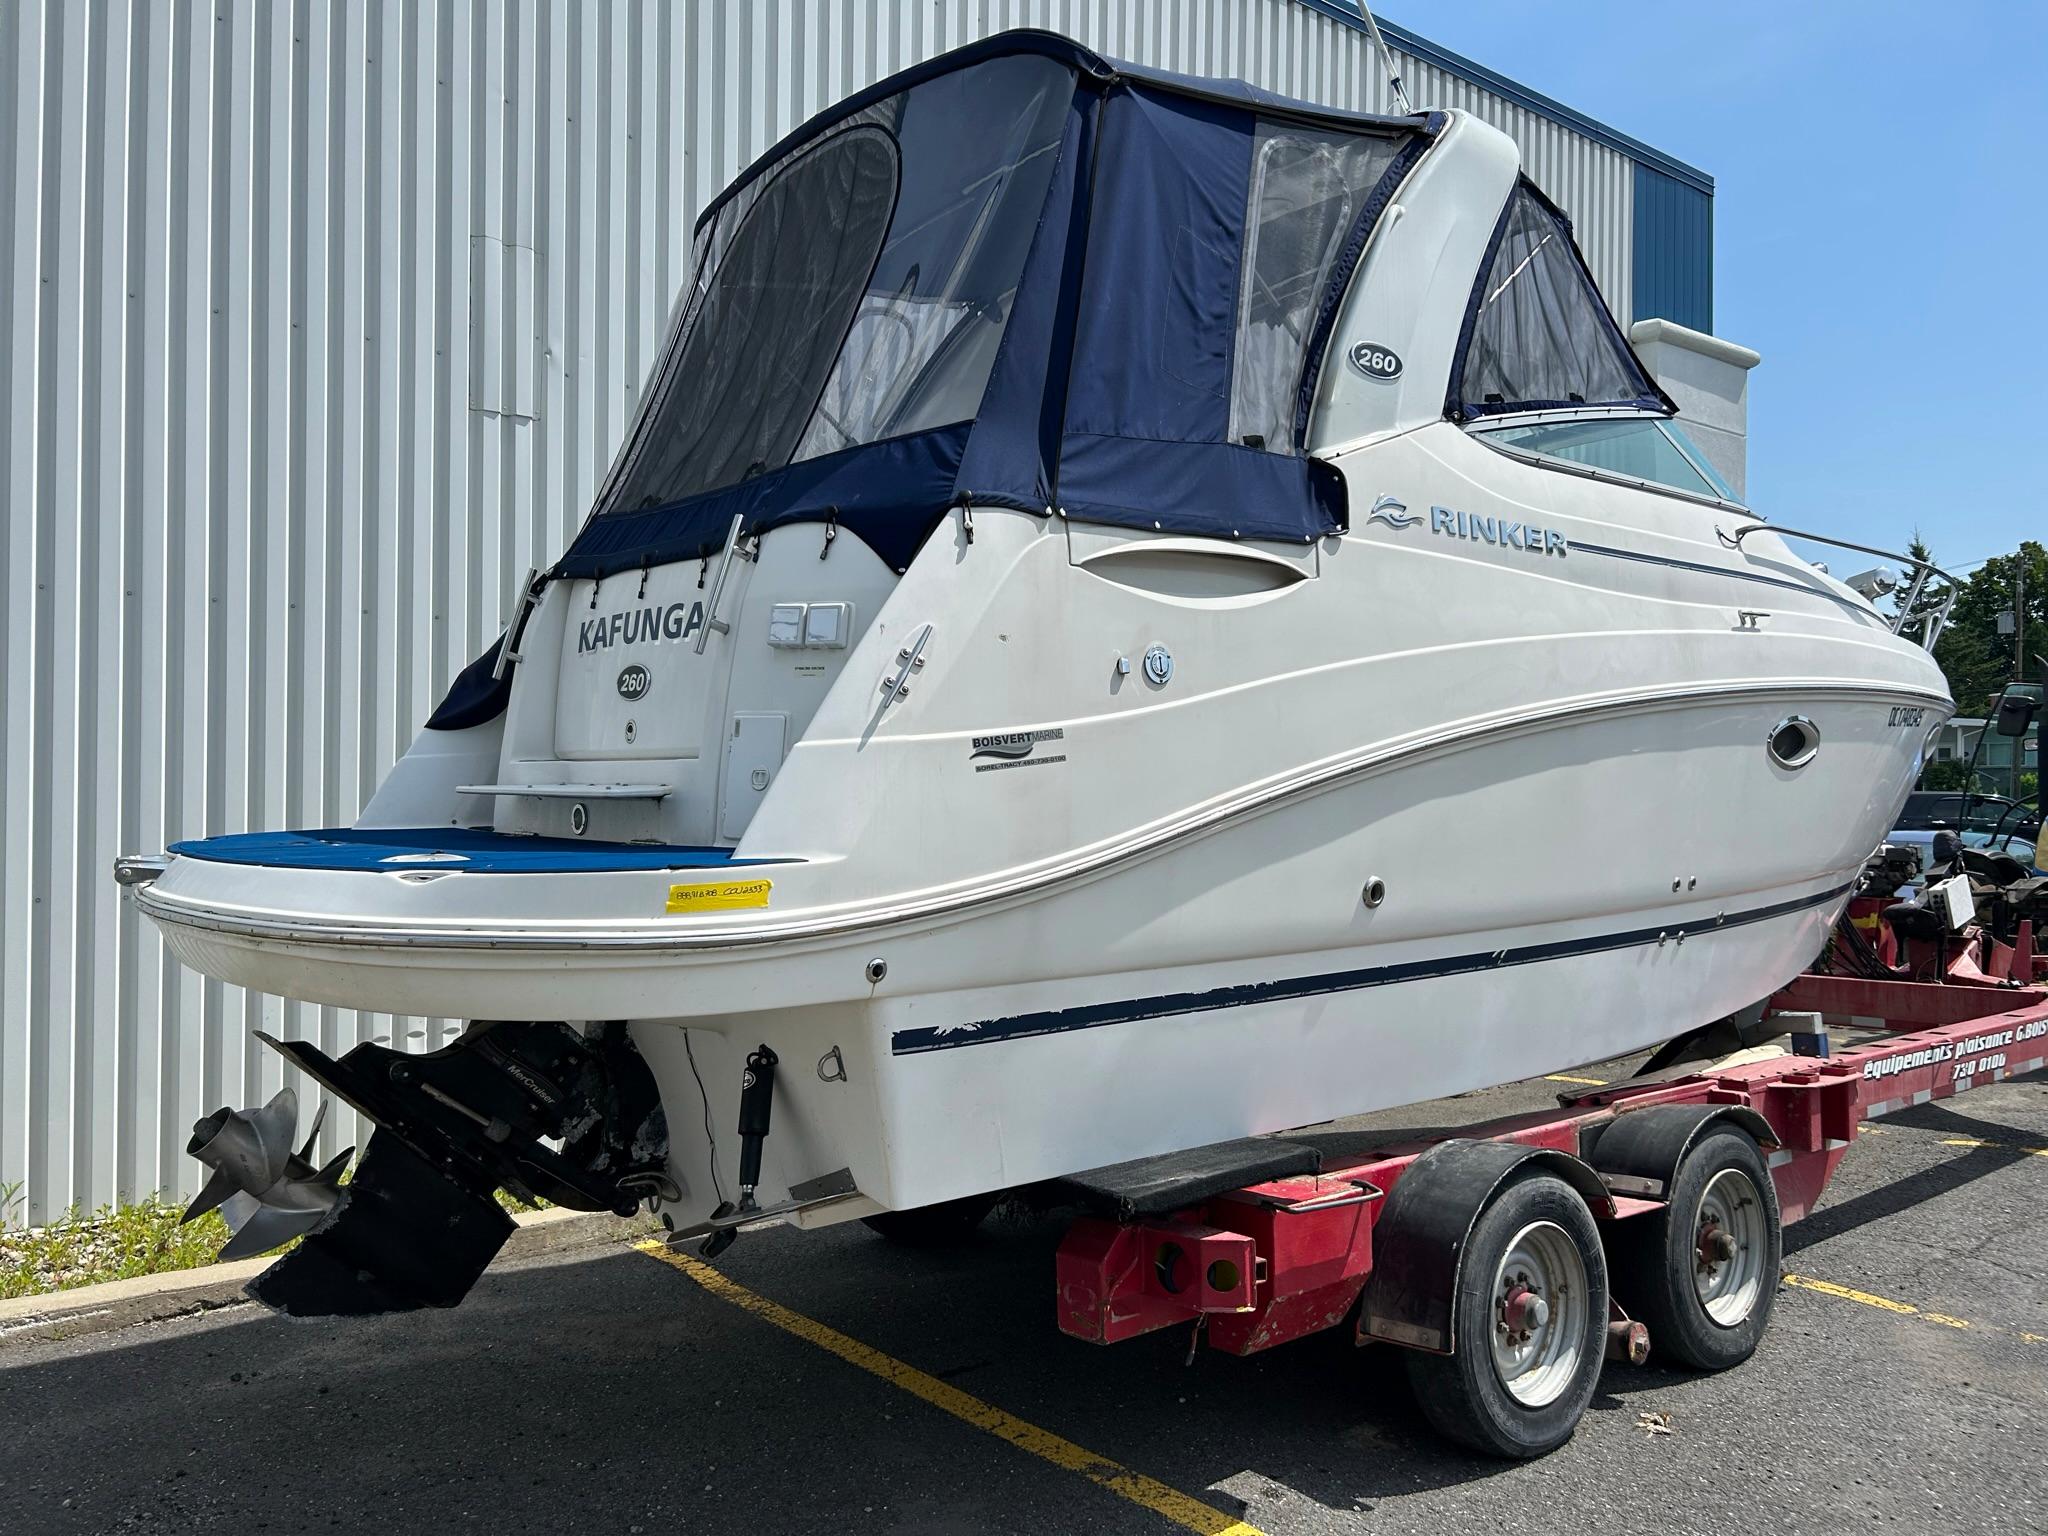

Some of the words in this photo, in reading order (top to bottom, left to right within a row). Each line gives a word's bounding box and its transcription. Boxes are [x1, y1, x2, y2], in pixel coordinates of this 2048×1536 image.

[1359, 349, 1396, 373] 260
[1430, 505, 1567, 558] RINKER
[578, 601, 704, 653] KAFUNGA
[620, 673, 646, 692] 260
[1863, 1044, 1953, 1080] équipements
[1955, 1029, 2014, 1060] plaisance
[507, 1065, 556, 1104] MerCruiser
